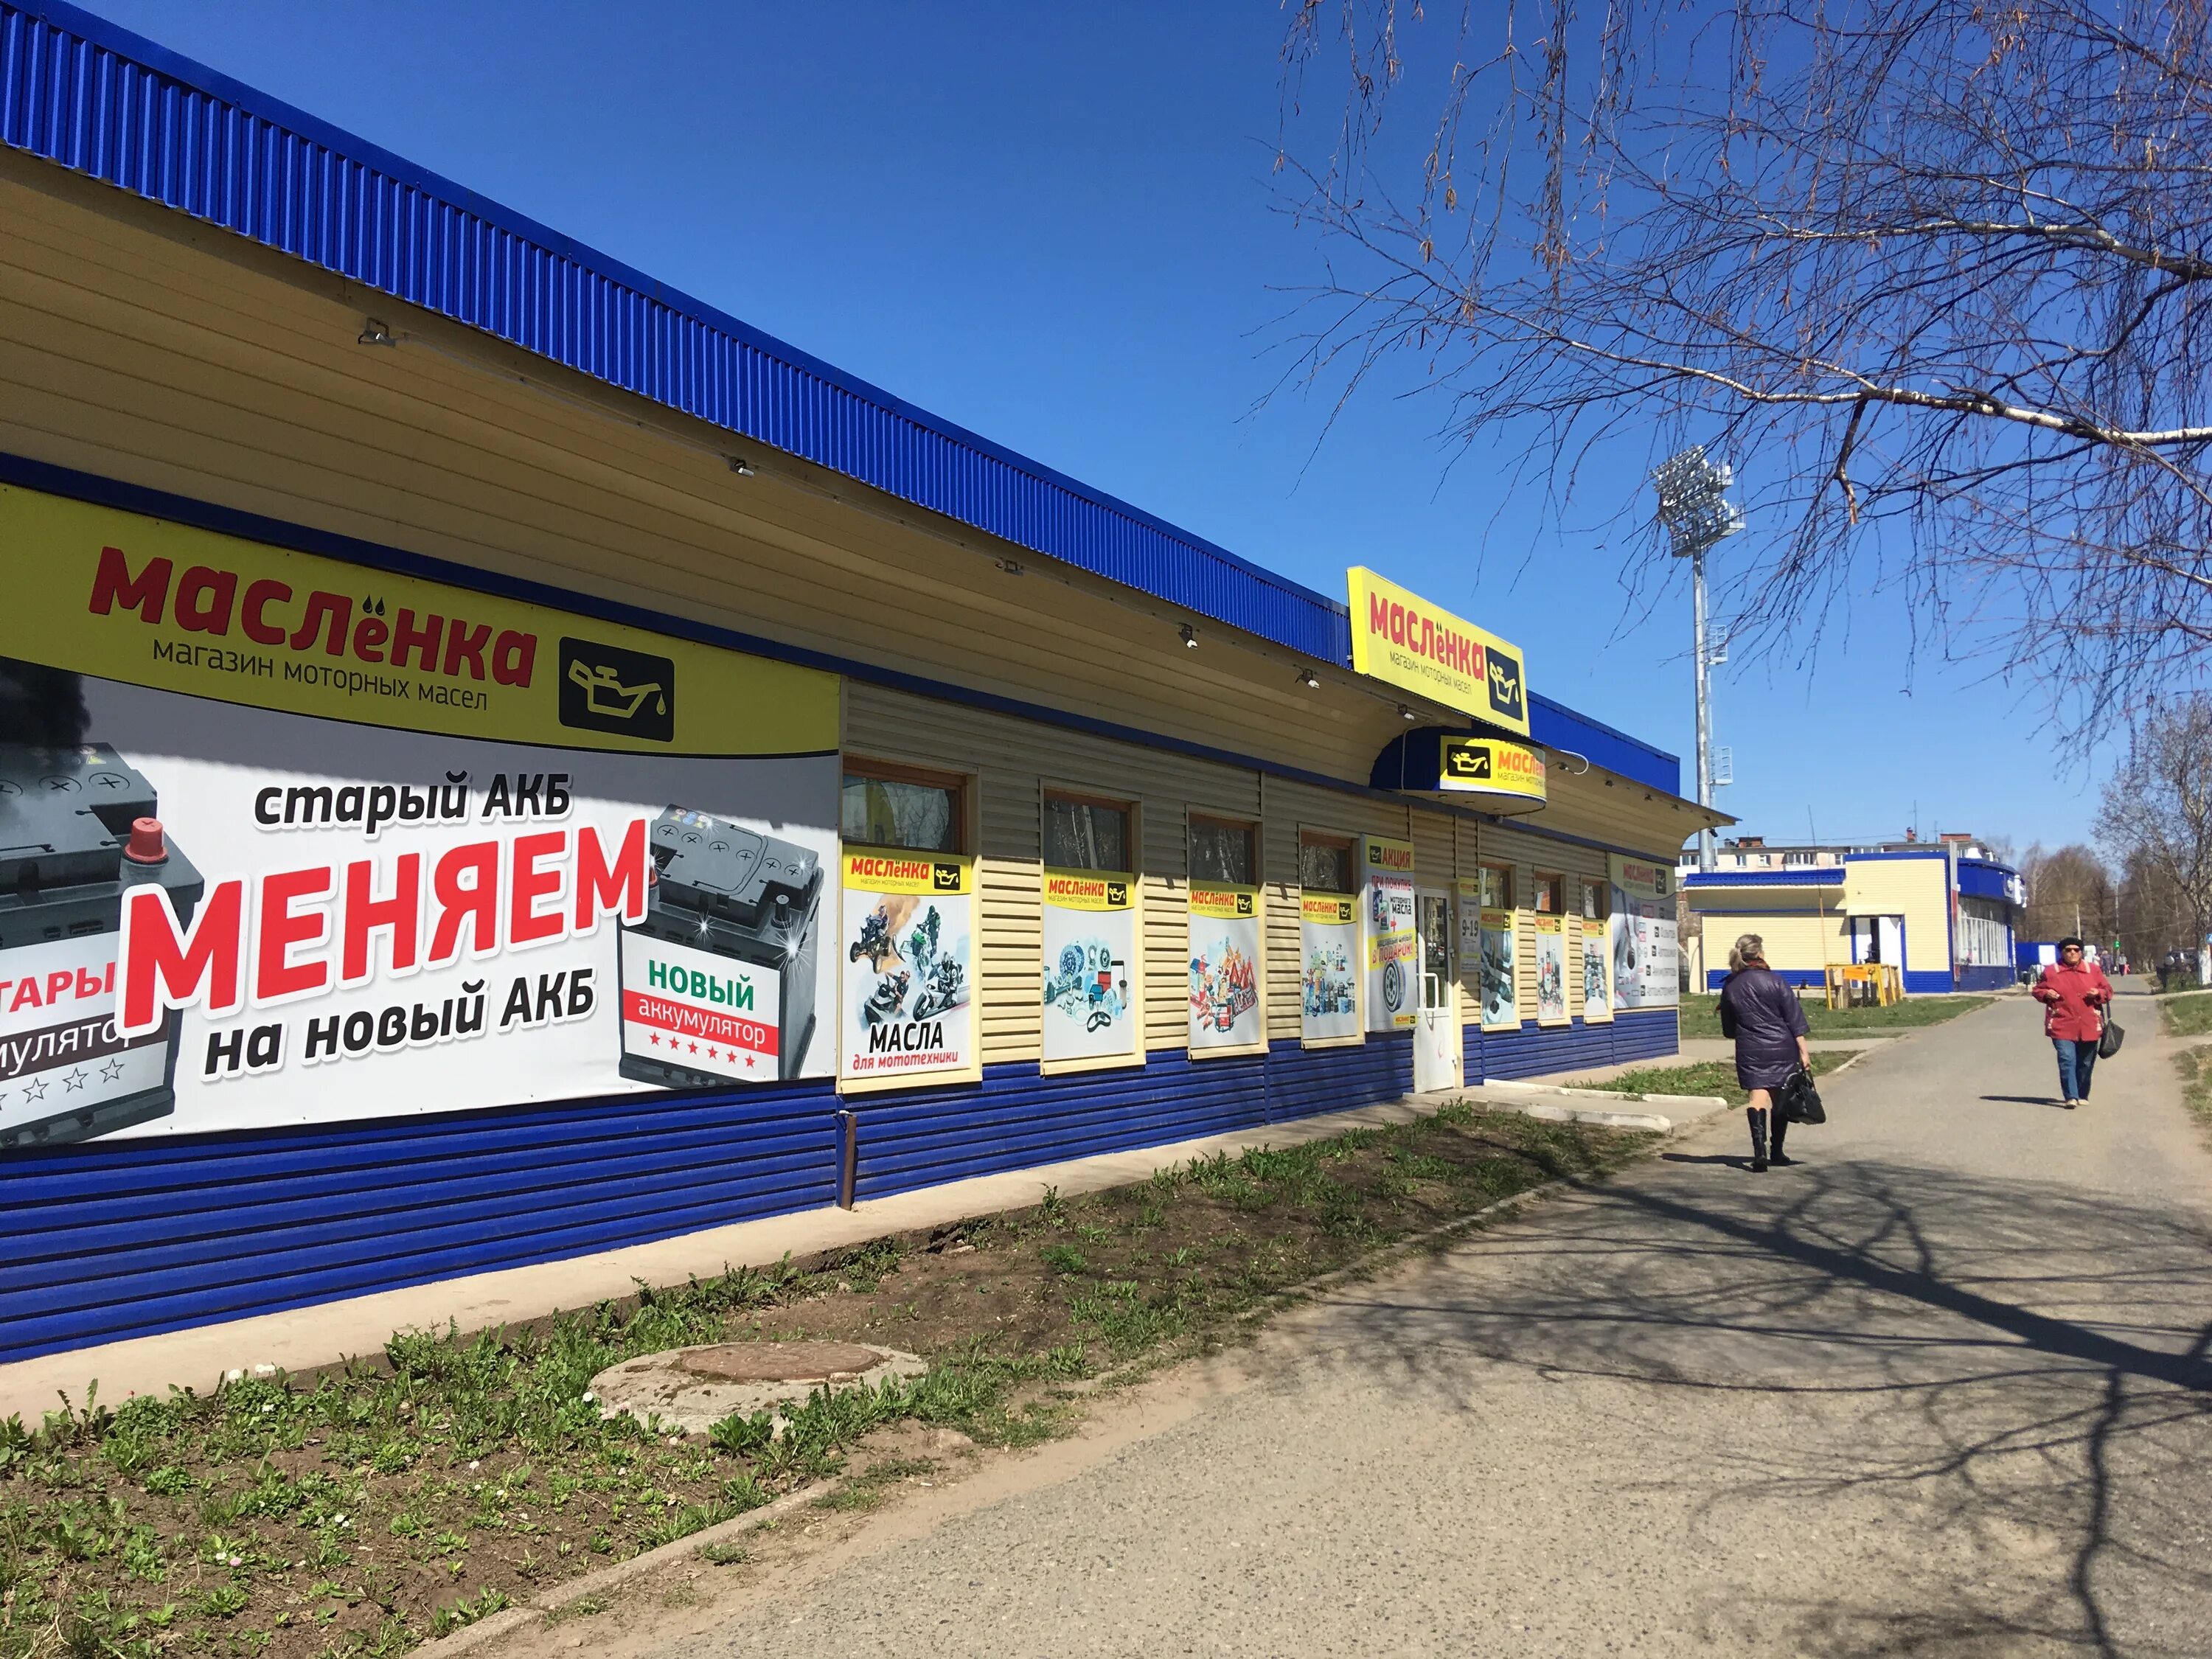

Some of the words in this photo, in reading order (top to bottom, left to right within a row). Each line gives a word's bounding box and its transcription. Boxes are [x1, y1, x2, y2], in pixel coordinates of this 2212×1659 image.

[153, 639, 274, 678] магазин
[284, 661, 410, 699] моторных
[417, 682, 488, 712] масел
[1389, 650, 1419, 674] магазин
[1420, 664, 1452, 686] моторных
[1453, 678, 1472, 695] масел
[254, 770, 468, 835] старый
[481, 773, 571, 817] АКБ
[1371, 874, 1384, 888] ПРИ
[1382, 847, 1411, 870] АКЦИЯ
[122, 818, 647, 1029] МЕНЯЕМ
[1391, 904, 1412, 914] масла
[1461, 919, 1479, 937] 9-19
[649, 959, 754, 1012] НОВЫЙ
[204, 1023, 282, 1075] на
[304, 978, 485, 1060] новый
[499, 967, 594, 1027] АКБ
[638, 998, 766, 1049] аккумулятор
[869, 1021, 944, 1054] МАСЛА
[852, 1054, 875, 1071] для
[877, 1051, 959, 1068] мототехники
